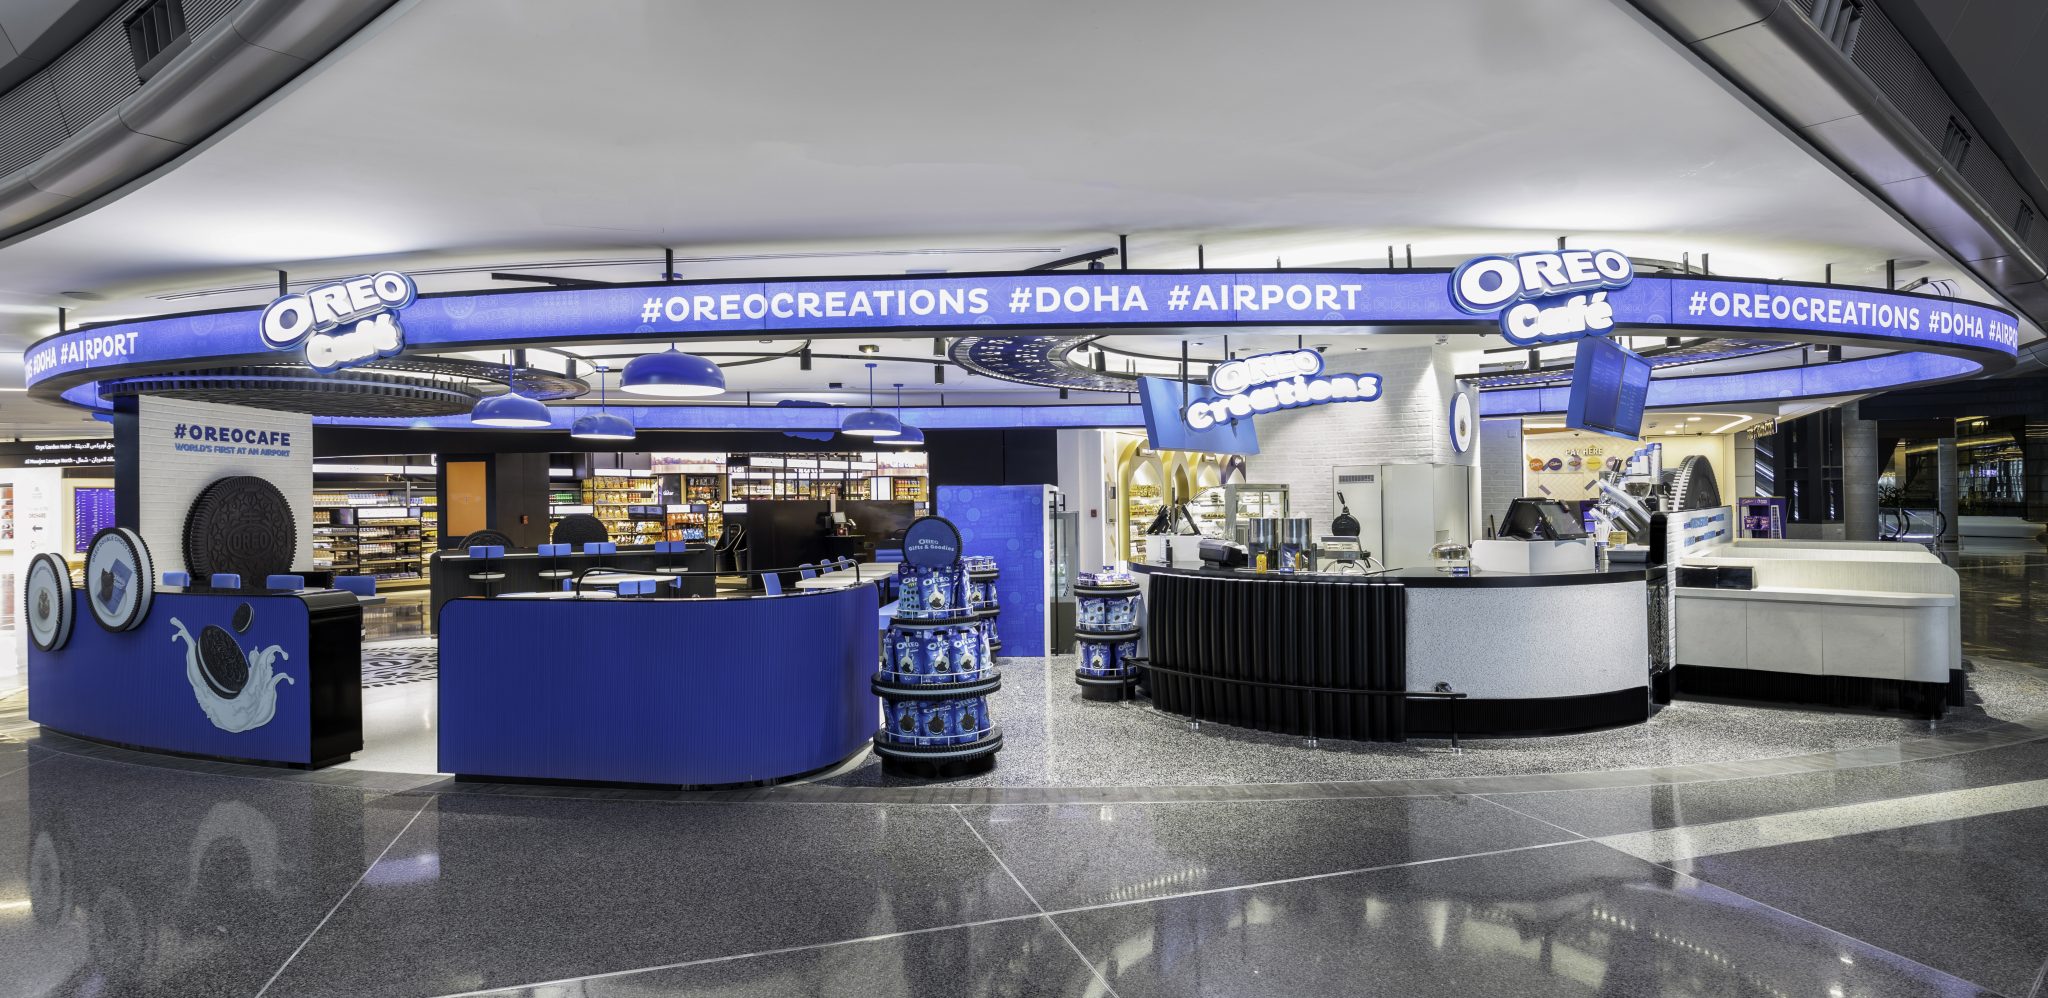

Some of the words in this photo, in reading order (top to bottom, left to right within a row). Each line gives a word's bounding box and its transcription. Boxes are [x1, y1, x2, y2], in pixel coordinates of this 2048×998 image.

[1460, 251, 1630, 305] OREO
[264, 274, 407, 343] OREO
[641, 287, 989, 324] #OREOCREATIONS
[1008, 285, 1149, 313] #DOHA
[1167, 284, 1362, 312] #AIRPORT
[1508, 291, 1614, 339] Café
[1688, 291, 1920, 331] #OREOCREATIONS
[1928, 310, 1984, 339] #DOHA
[33, 346, 57, 377] #DOHA
[60, 332, 138, 366] #AIRPORT
[174, 423, 291, 447] #OREOCAFE
[175, 443, 213, 453] WORLD'S
[214, 446, 236, 455] FIRST
[236, 447, 247, 455] AT
[247, 447, 260, 456] AN
[260, 448, 291, 457] AIRPORT
[1565, 448, 1580, 456] PAY
[1583, 447, 1604, 457] HERE
[231, 532, 268, 550] OREO
[929, 544, 955, 552] Goodies
[896, 641, 920, 650] OREO
[953, 637, 977, 648] OREO
